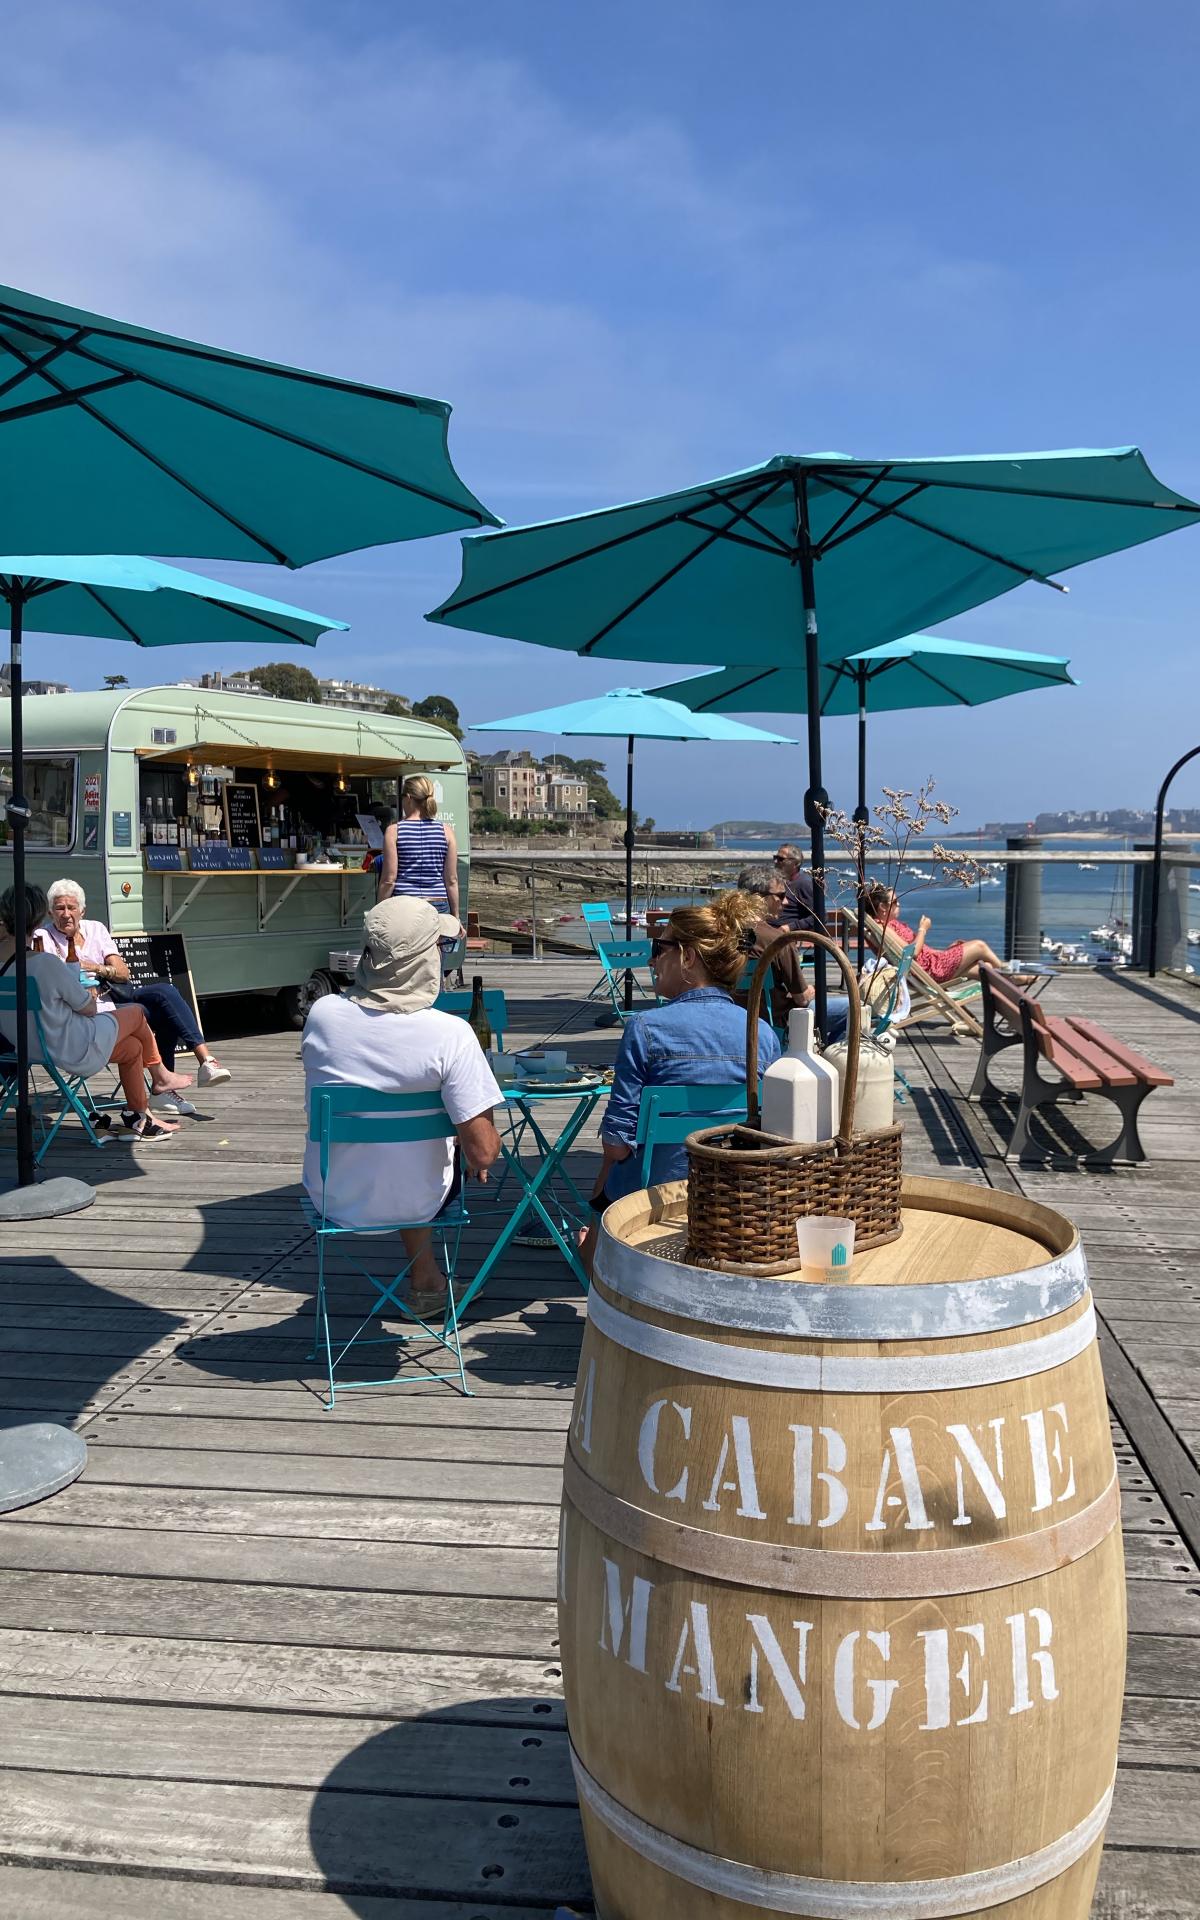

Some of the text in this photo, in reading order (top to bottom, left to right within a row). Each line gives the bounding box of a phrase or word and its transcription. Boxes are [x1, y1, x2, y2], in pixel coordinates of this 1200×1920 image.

[527, 1238, 554, 1246] crocs
[638, 1399, 1076, 1530] CABANE
[598, 1556, 1060, 1731] MANGER
